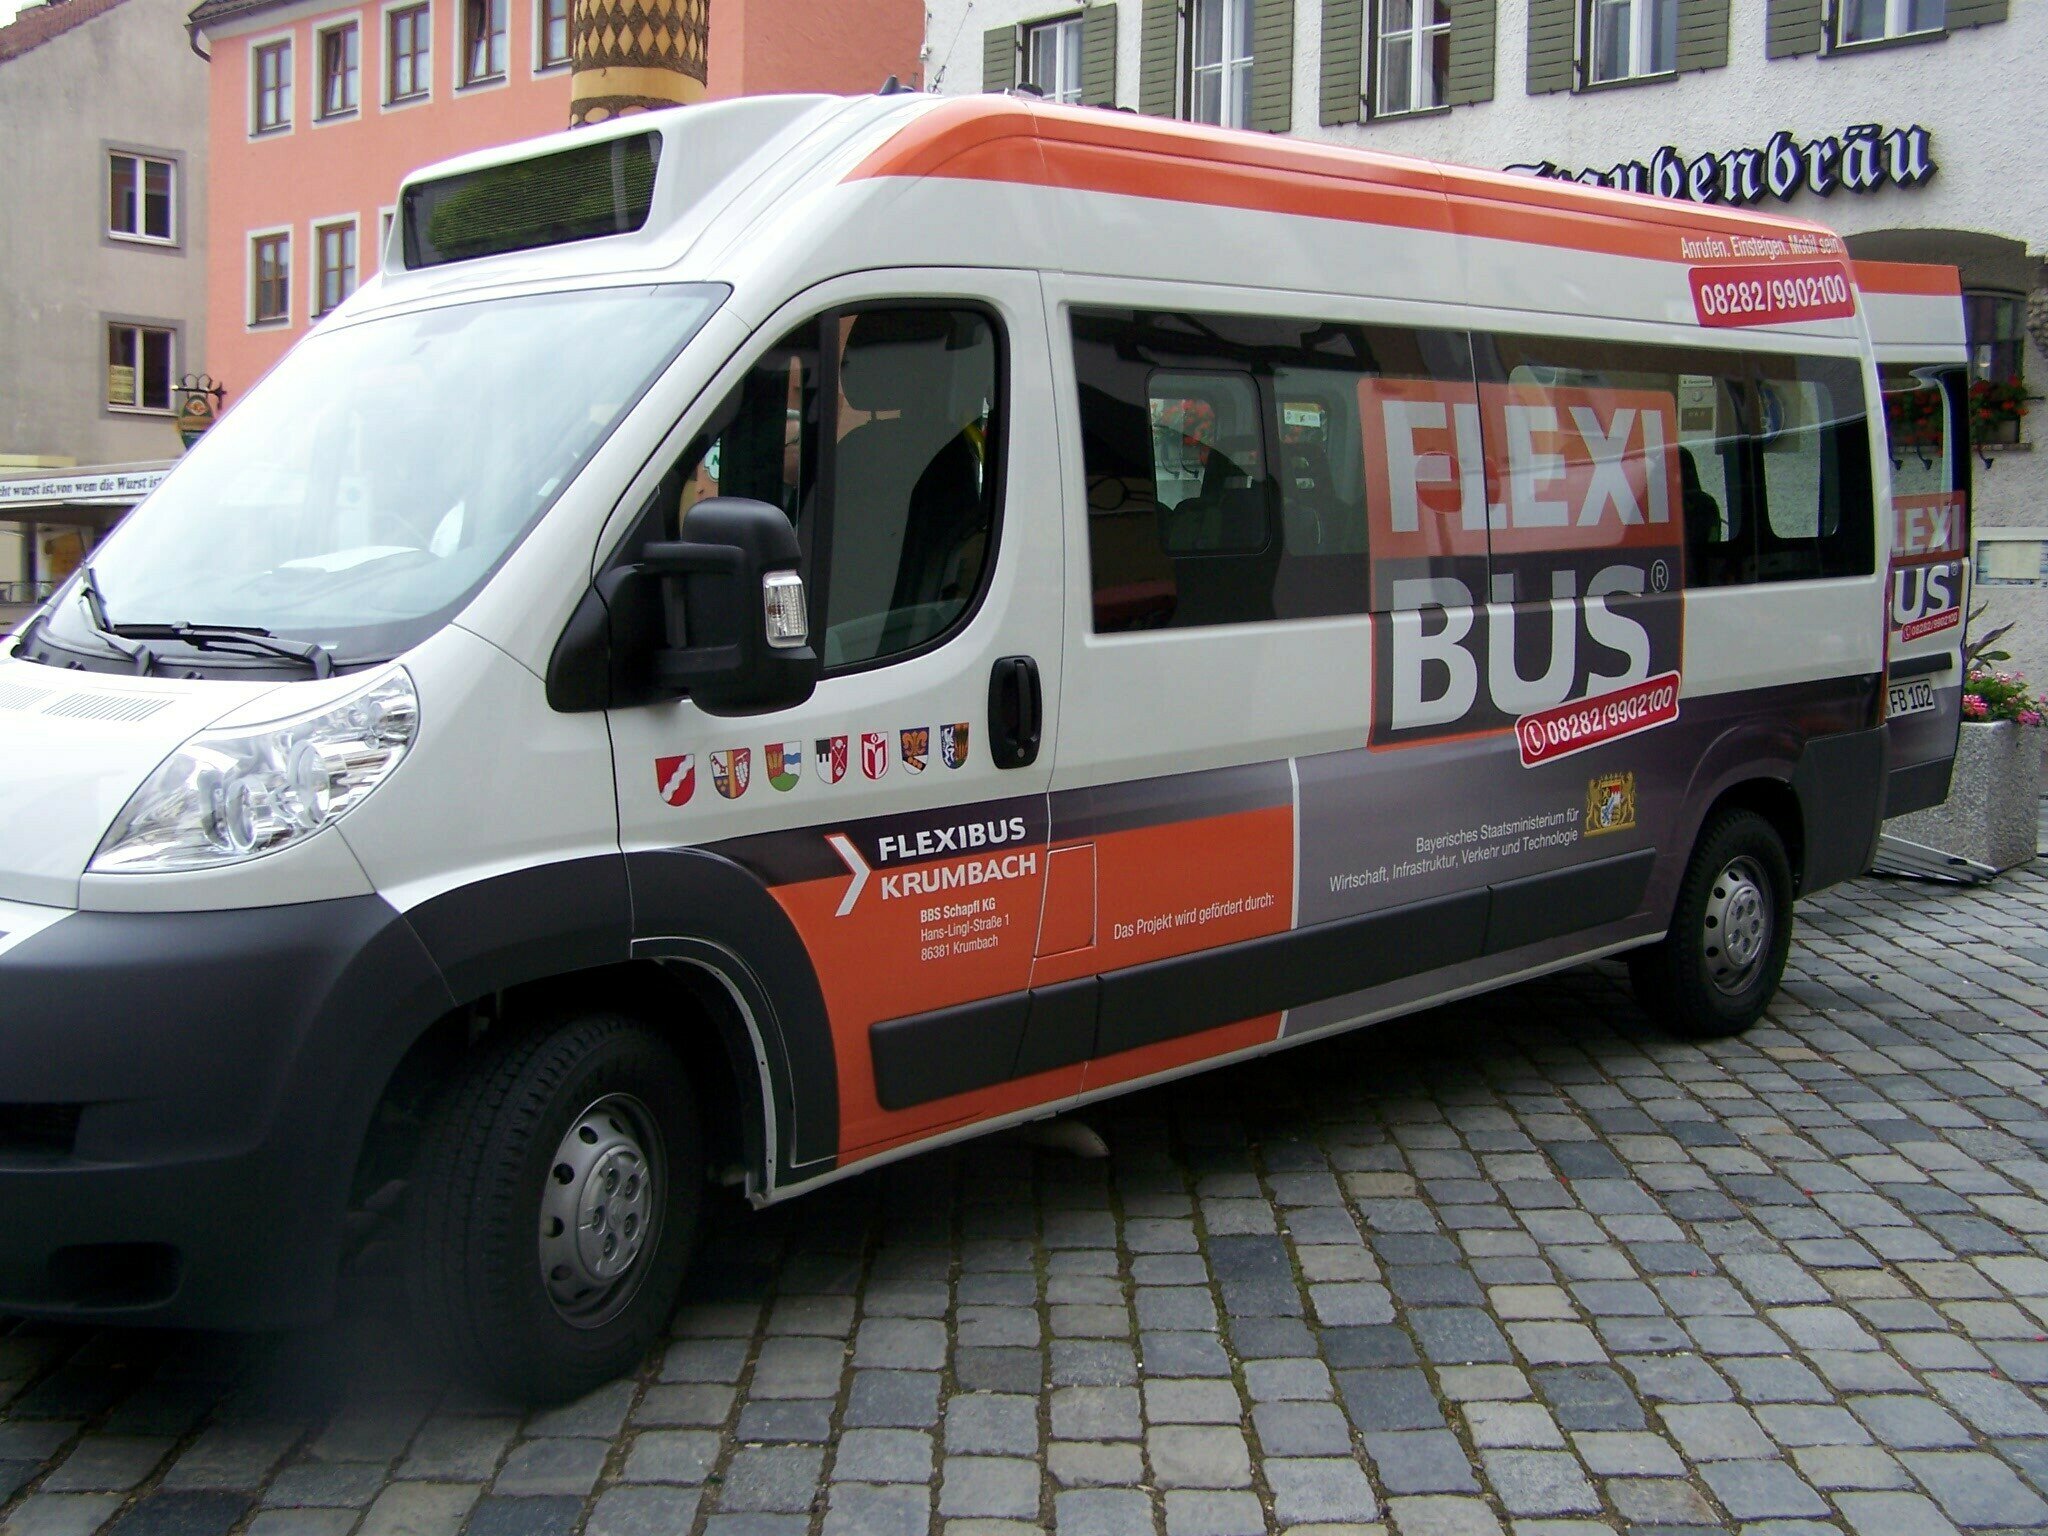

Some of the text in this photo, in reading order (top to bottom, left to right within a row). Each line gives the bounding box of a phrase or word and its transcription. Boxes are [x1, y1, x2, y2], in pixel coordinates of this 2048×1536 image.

[1681, 234, 1843, 261] Anrufen. Einsteigen. Mobil sein.
[1701, 274, 1847, 316] 08282/9902100
[13, 485, 40, 496] wurst
[76, 482, 98, 492] wem
[100, 478, 114, 491] die
[117, 476, 147, 490] Wurst
[1382, 400, 1670, 532] FLEXI
[1546, 685, 1672, 745] 08282/9902100
[1889, 683, 1932, 714] FB 102
[878, 817, 1026, 861] FLEXIBUS
[1416, 808, 1579, 854] Bayerisches Staatsministerium für
[881, 852, 1037, 900] KRUMBACH
[1329, 827, 1578, 893] Wirtschaft, Infrastruktur, Verkehr und Technologie
[920, 897, 996, 923] BBS Schapfl KG
[920, 913, 1010, 942] Hans-Lingl-Straße 1
[1114, 892, 1275, 940] Das Projekt wird gefördert durch:
[921, 934, 999, 961] 86381 Krumbach
